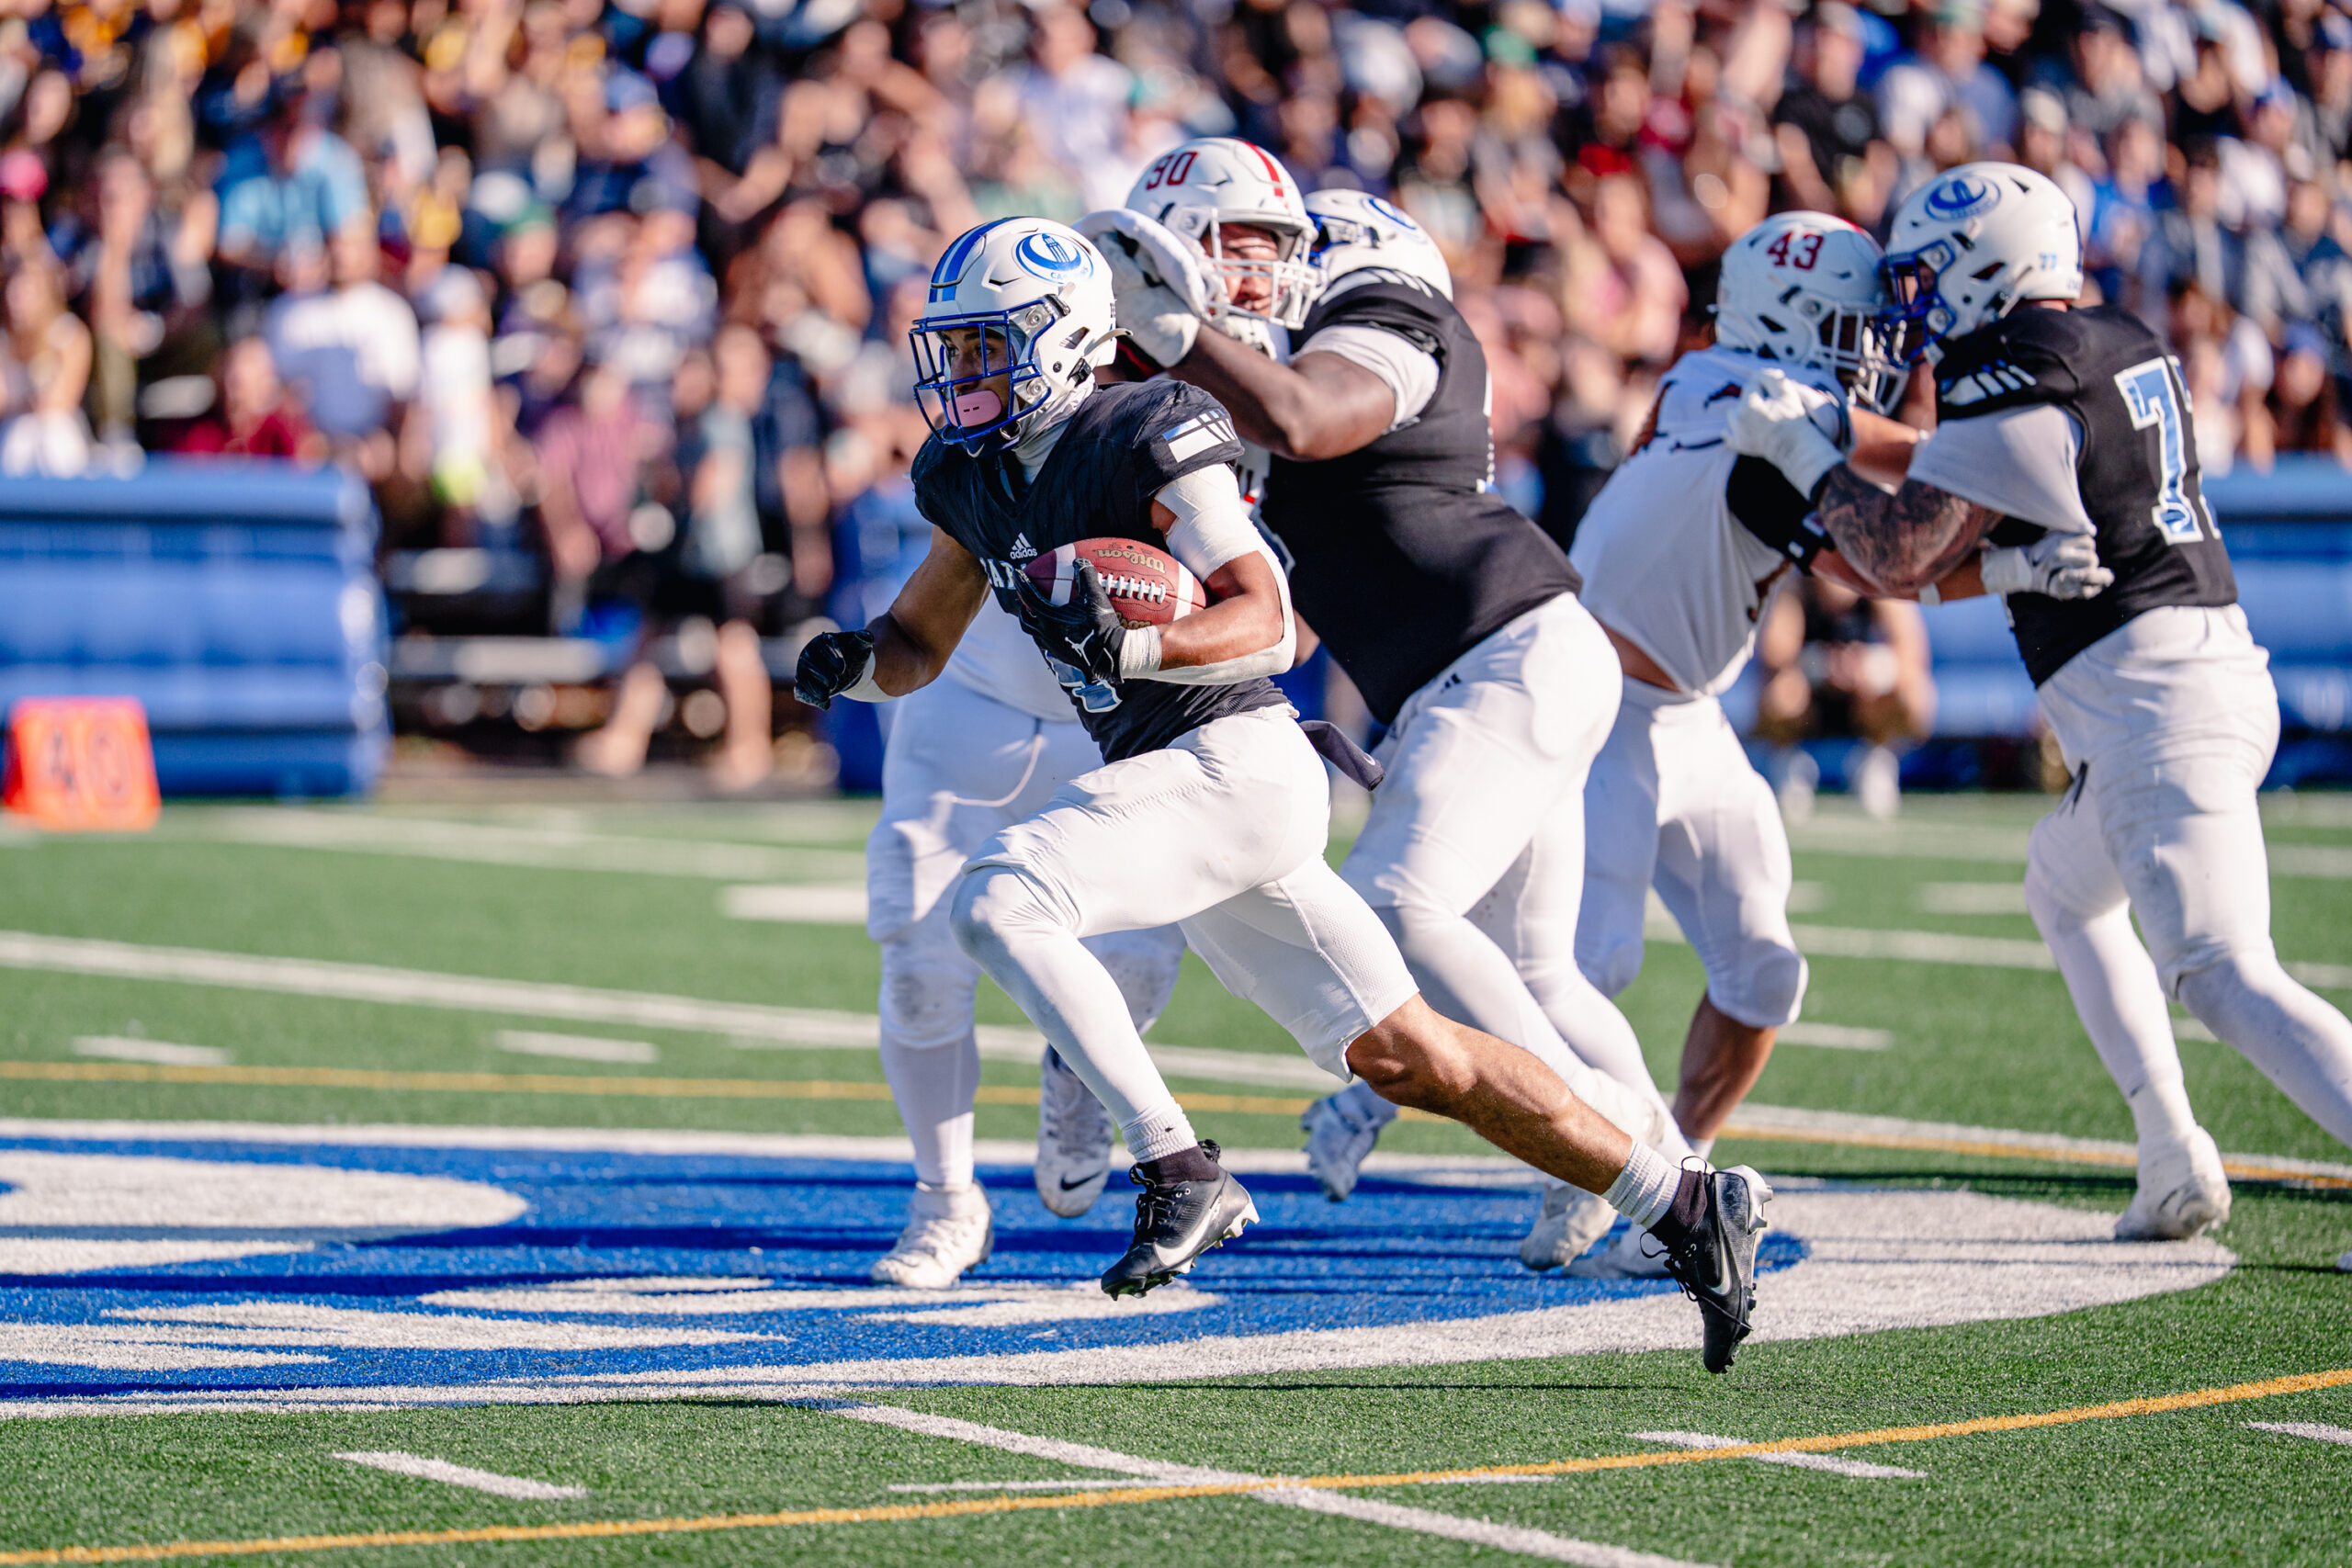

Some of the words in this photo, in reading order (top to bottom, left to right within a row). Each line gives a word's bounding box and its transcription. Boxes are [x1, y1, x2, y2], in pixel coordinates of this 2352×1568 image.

[1146, 152, 1199, 190] 90
[1767, 230, 1825, 271] 43
[2039, 252, 2058, 270] 77
[2114, 355, 2222, 545] 7
[1010, 547, 1038, 559] adidas
[1093, 548, 1166, 574] Wilson
